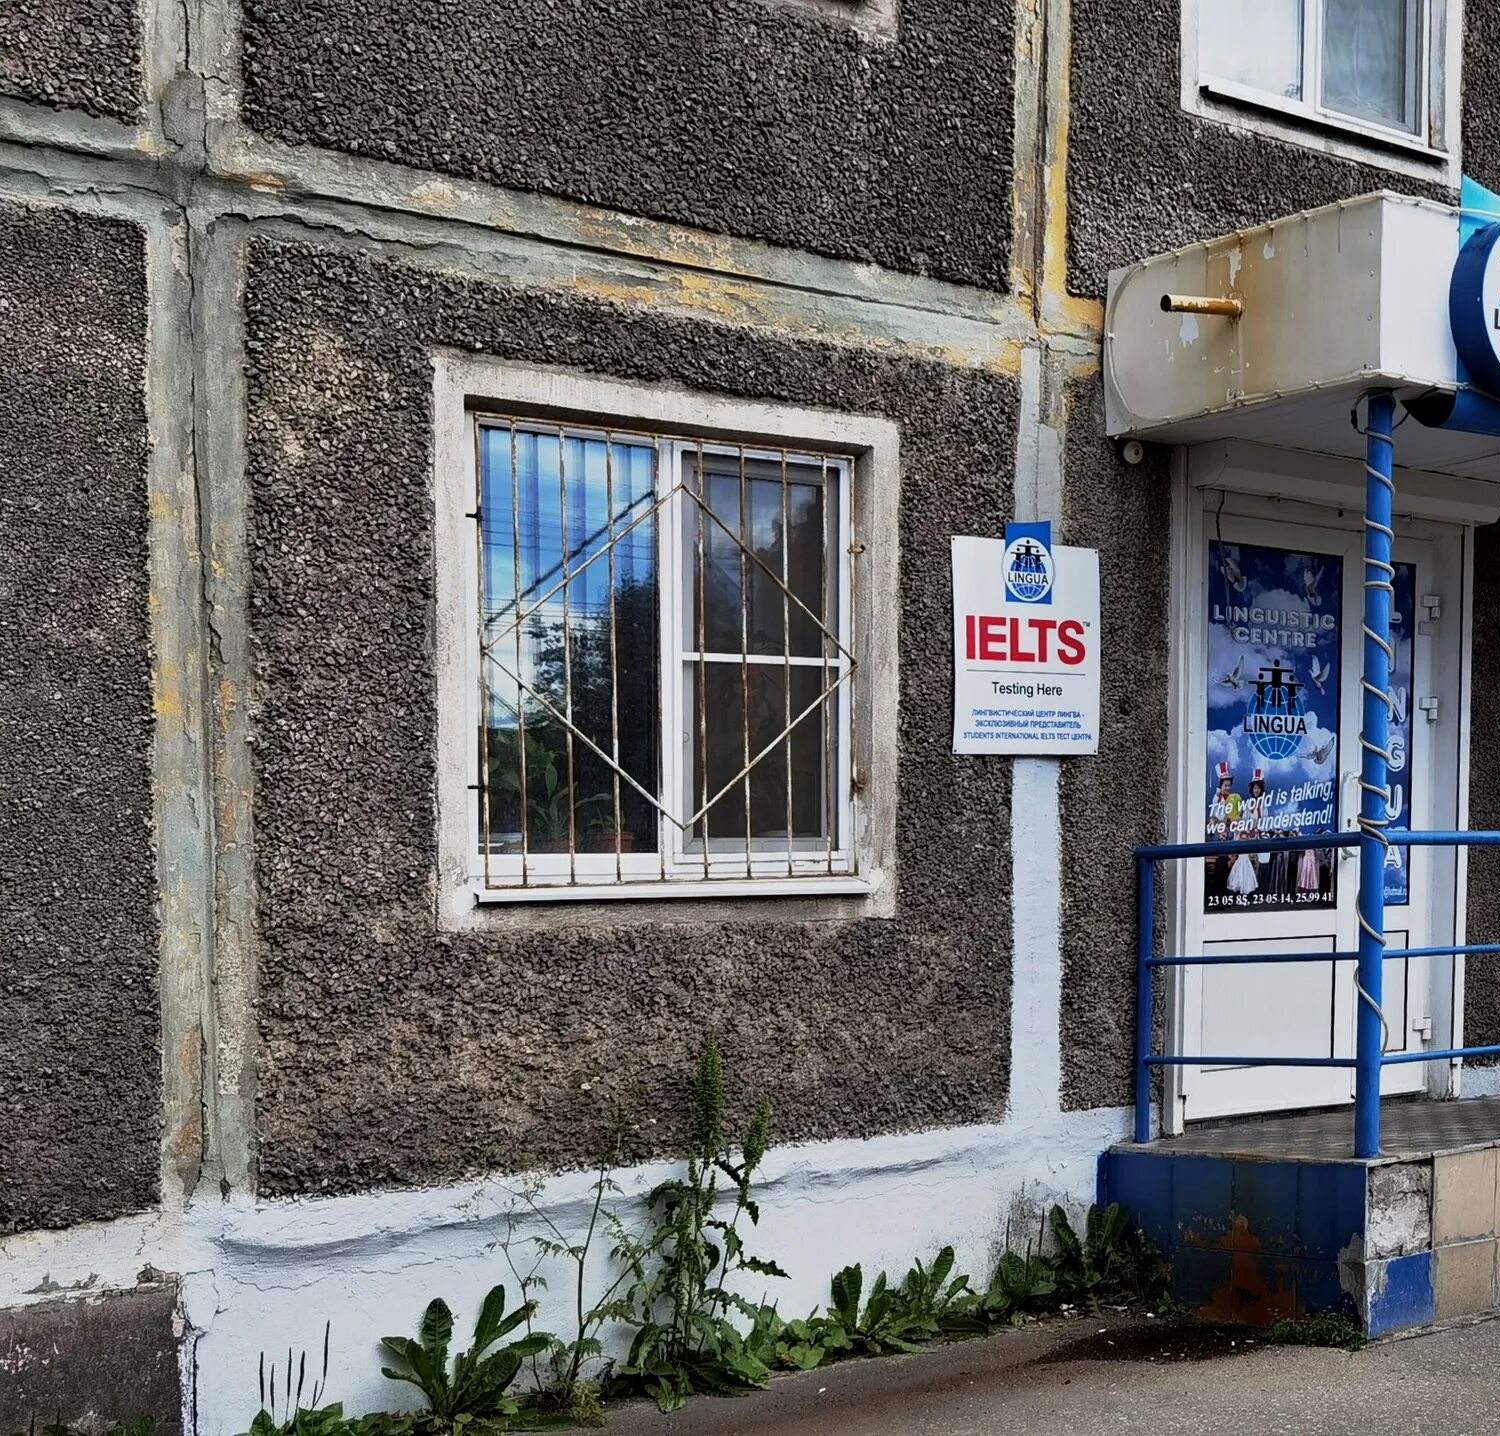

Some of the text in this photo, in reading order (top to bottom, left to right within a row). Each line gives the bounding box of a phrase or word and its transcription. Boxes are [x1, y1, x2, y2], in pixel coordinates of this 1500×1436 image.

[1008, 571, 1049, 586] LINGUA
[1213, 603, 1336, 631] LINGUISTIC
[965, 615, 1086, 665] IELTS
[1233, 626, 1318, 649] CENTRE
[992, 681, 1063, 698] Testing Here
[972, 708, 1034, 717] ЛИНГВИСТИЧЕСКИЙ
[1036, 710, 1055, 718] ЦЕНТР
[1243, 715, 1308, 735] LINGUA
[963, 732, 994, 740] STUDENTS
[995, 732, 1039, 740] INTERNATIONAL
[1208, 780, 1334, 817] The world is talking,
[1206, 804, 1333, 835] we can understand!
